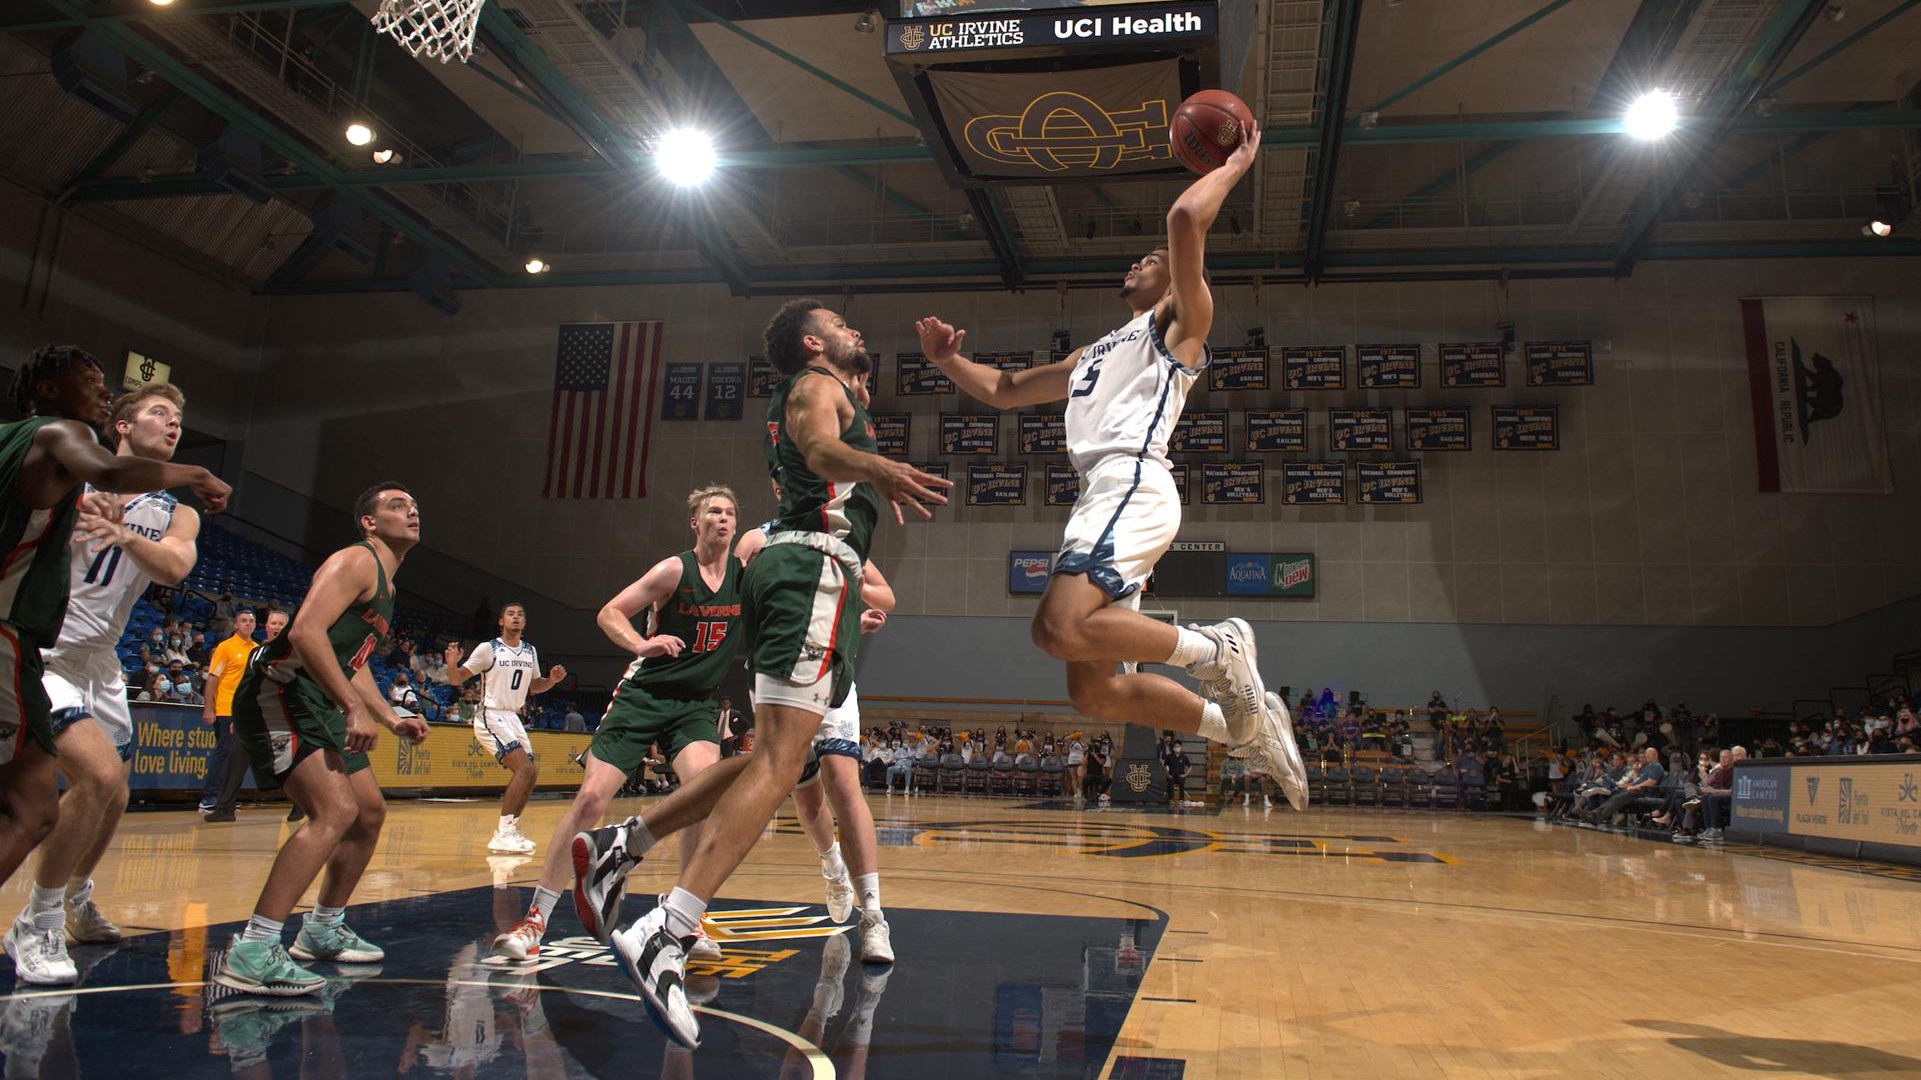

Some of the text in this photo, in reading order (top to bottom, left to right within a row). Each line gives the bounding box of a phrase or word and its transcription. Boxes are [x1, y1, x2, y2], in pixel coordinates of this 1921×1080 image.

[929, 19, 1021, 37] UC IRVINE
[1054, 11, 1202, 39] UCI Health
[928, 31, 1024, 49] ATHLETICS
[1071, 358, 1103, 398] 5
[670, 384, 695, 400] 44
[713, 384, 737, 400] 12
[1774, 341, 1794, 443] CALIFORNIA REPUBLIC
[1014, 557, 1049, 569] PEPSI
[1230, 566, 1266, 582] AQUAFINA
[692, 621, 728, 654] 15
[511, 660, 533, 669] IRVINE
[511, 669, 523, 691] 0
[137, 720, 185, 748] Where
[134, 748, 166, 774] love
[1752, 790, 1777, 800] CAMPUS
